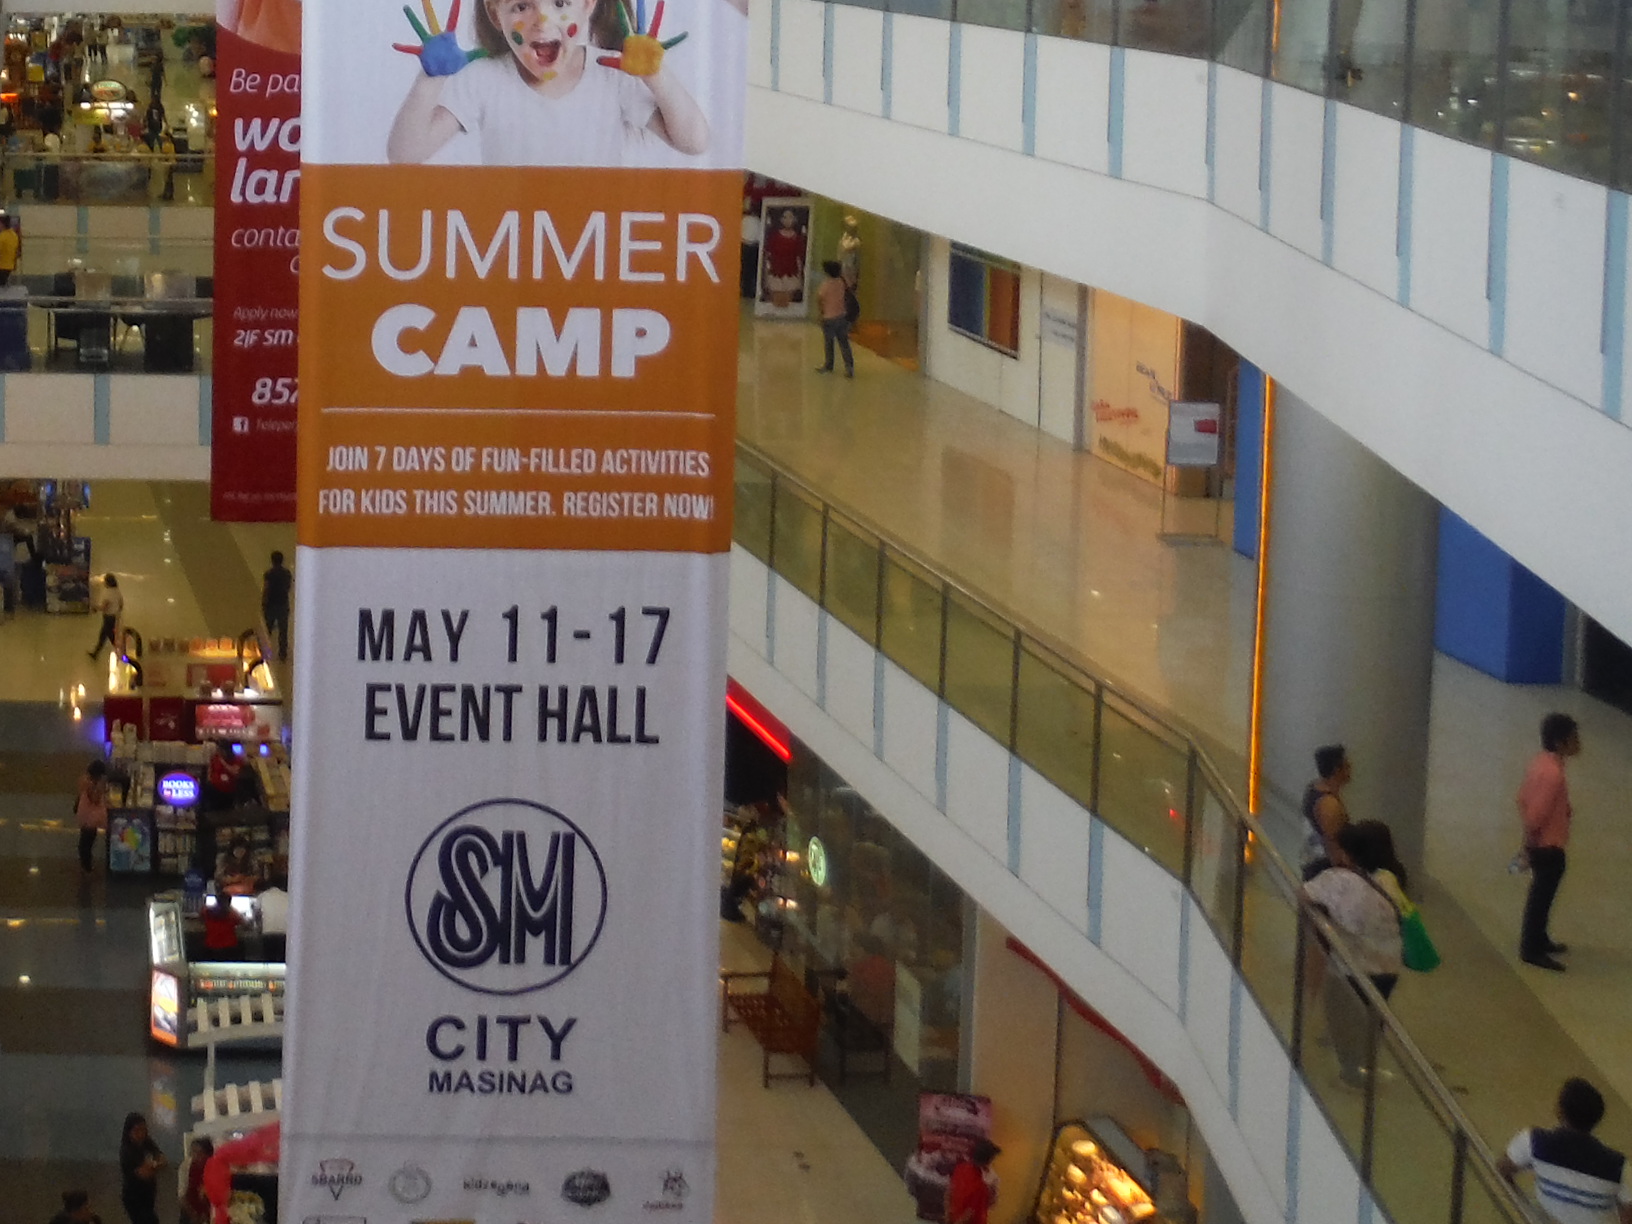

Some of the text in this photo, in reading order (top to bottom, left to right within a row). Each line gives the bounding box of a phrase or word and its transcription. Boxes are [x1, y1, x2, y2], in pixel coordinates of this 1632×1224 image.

[230, 68, 261, 93] Be
[322, 206, 721, 282] SUMMER
[371, 303, 670, 377] CAMP
[326, 446, 710, 476] JOIN 7 DAYS OF FUN-FILLED ACTIVITIES
[319, 489, 354, 515] FOR
[361, 489, 407, 515] KIDS
[414, 489, 457, 516] THIS
[563, 492, 657, 519] REGISTER
[664, 493, 714, 520] NOW!
[358, 608, 470, 663] MAY
[365, 682, 659, 744] EVENT HALL
[163, 780, 194, 789] BOOKS
[427, 825, 575, 968] SM
[426, 1014, 577, 1061] CITY
[429, 1070, 573, 1095] MASINAG
